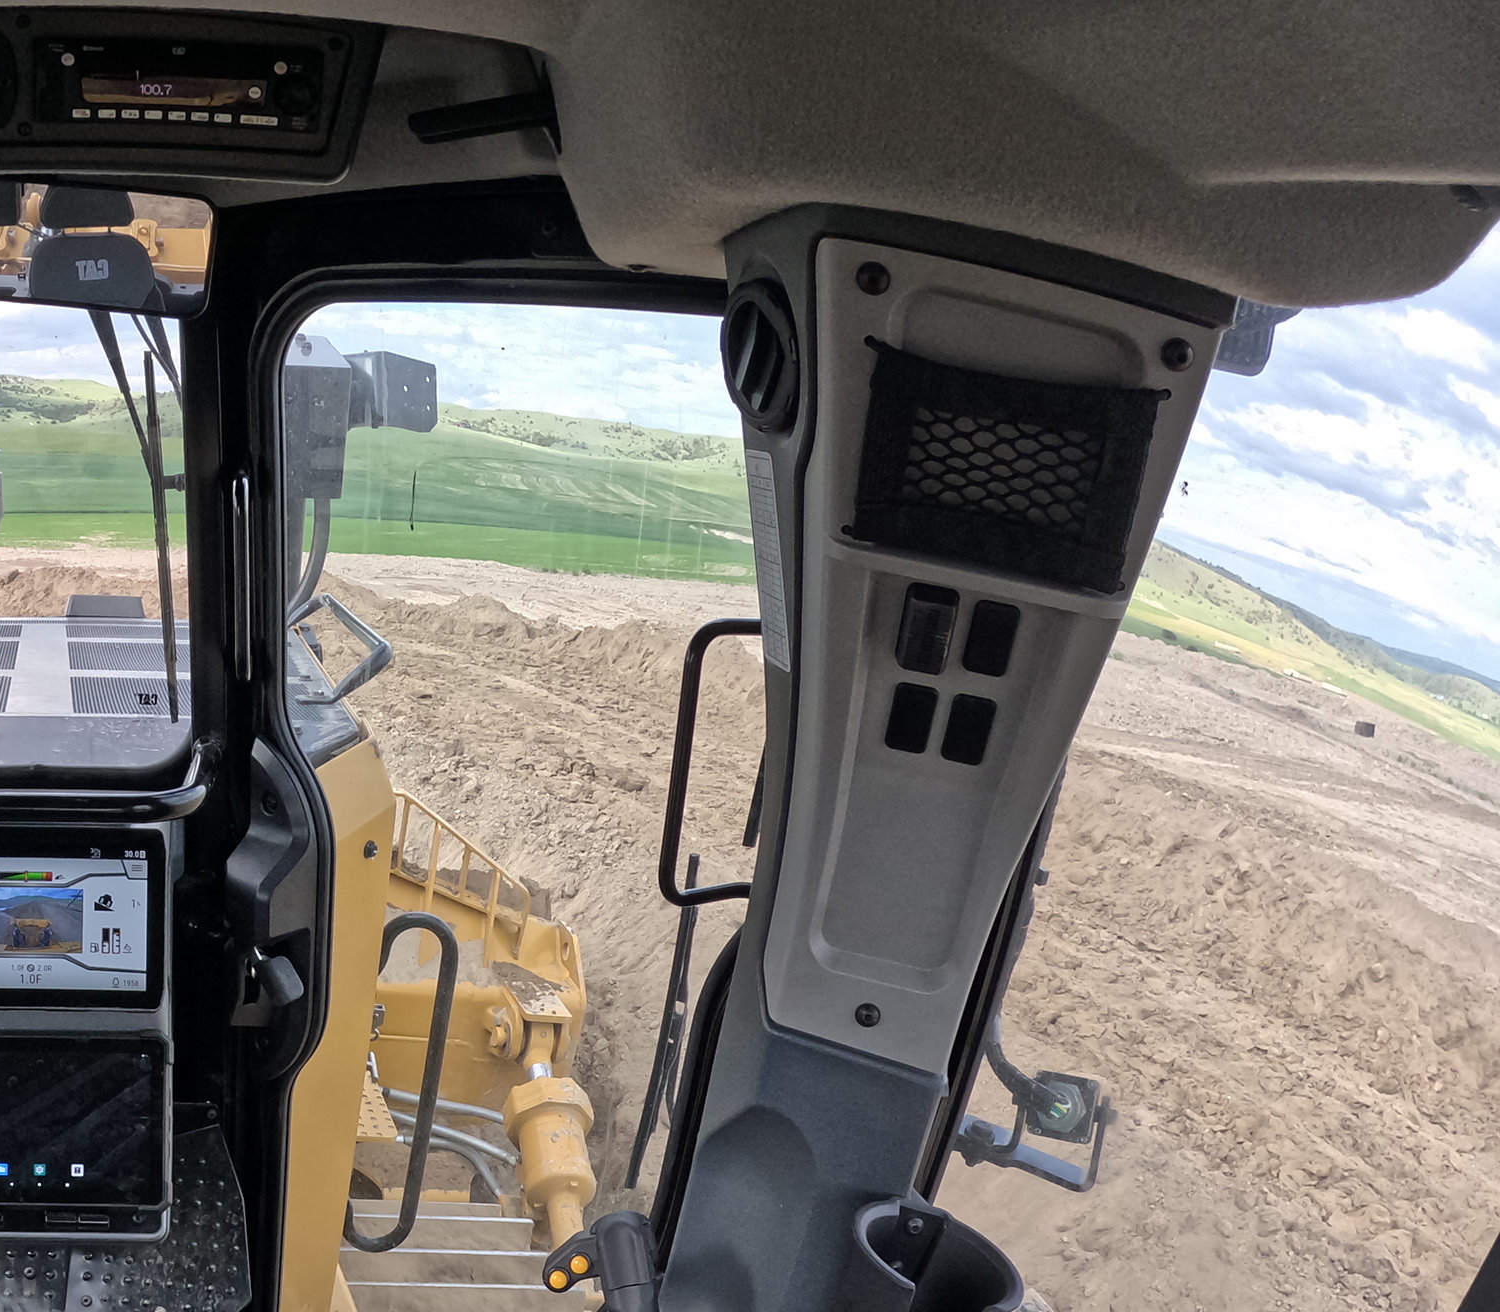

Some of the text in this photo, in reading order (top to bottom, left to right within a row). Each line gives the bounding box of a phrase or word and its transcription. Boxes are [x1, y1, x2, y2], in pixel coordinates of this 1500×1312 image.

[140, 84, 172, 96] 100.7
[124, 850, 139, 858] 30.0
[37, 964, 52, 972] 2.0R
[20, 973, 42, 984] 1.0F
